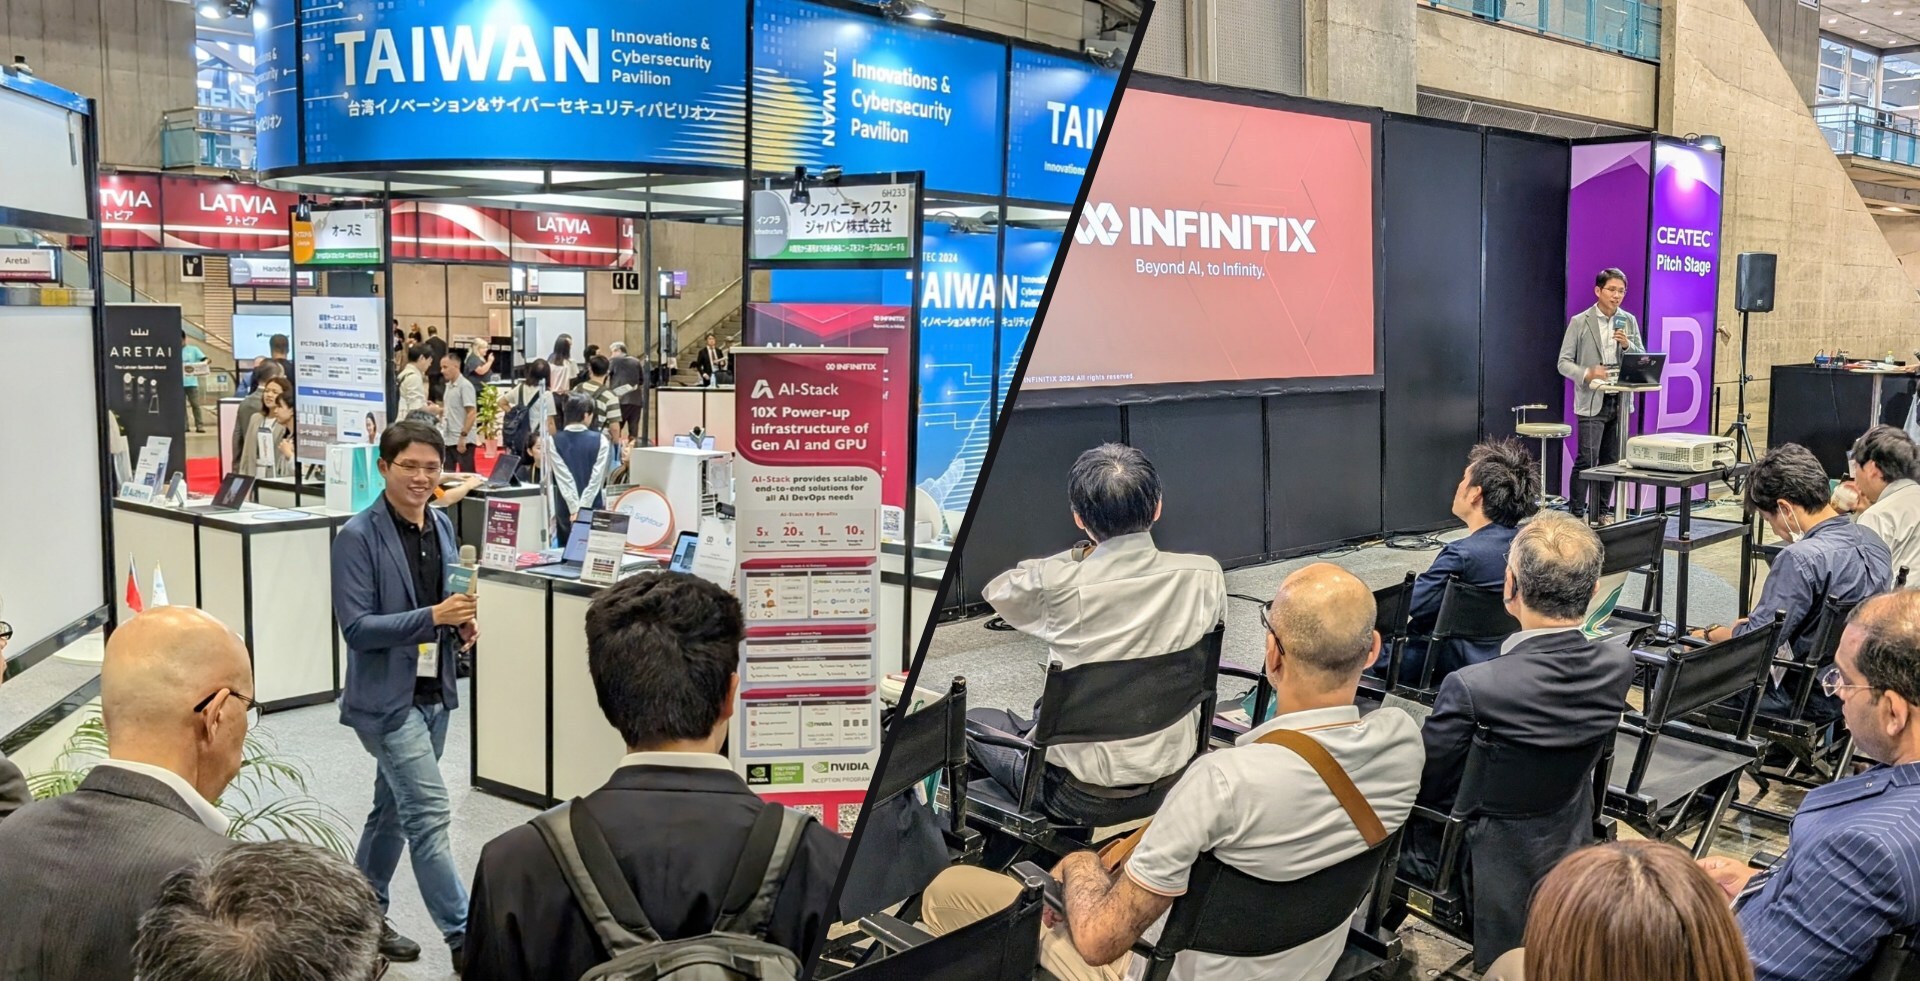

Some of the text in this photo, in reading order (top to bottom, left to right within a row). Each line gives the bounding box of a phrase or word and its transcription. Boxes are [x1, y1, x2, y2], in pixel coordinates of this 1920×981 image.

[611, 29, 711, 50] Innovations &
[335, 25, 599, 86] TAIWAN
[611, 49, 712, 73] Cybersecurity
[612, 69, 671, 86] Pavilion
[852, 58, 951, 93] Innovations &
[822, 48, 837, 147] TAIWAN
[852, 88, 951, 126] Cybersecurity
[851, 118, 909, 144] Pavilion
[99, 189, 152, 208] TVIA
[882, 188, 907, 198] 6H233
[200, 193, 277, 215] LATVIA
[537, 216, 591, 235] LATVIA
[757, 215, 781, 225] インフラ
[805, 218, 892, 234] ジャパン株式会社
[332, 223, 362, 237] オースミ
[622, 224, 633, 238] LA
[1130, 207, 1316, 253] INFINITIX
[938, 252, 958, 263] 2024
[1657, 254, 1711, 277] Pitch Stage
[1136, 259, 1265, 280] Beyond AI, to Infinity.
[906, 271, 1018, 309] AIWAN
[110, 346, 172, 358] ARETAI
[836, 363, 876, 371] INFINITIX
[1657, 317, 1702, 430] B
[1087, 374, 1105, 382] rights
[778, 383, 839, 396] AI-Stack
[751, 406, 850, 421] 10X Power-up
[751, 422, 869, 434] infrastructure of
[751, 439, 867, 450] Gen AI and GPU
[793, 475, 831, 485] provides
[808, 484, 848, 492] solutions
[792, 494, 826, 503] DevOps
[831, 762, 870, 772] NVIDIA
